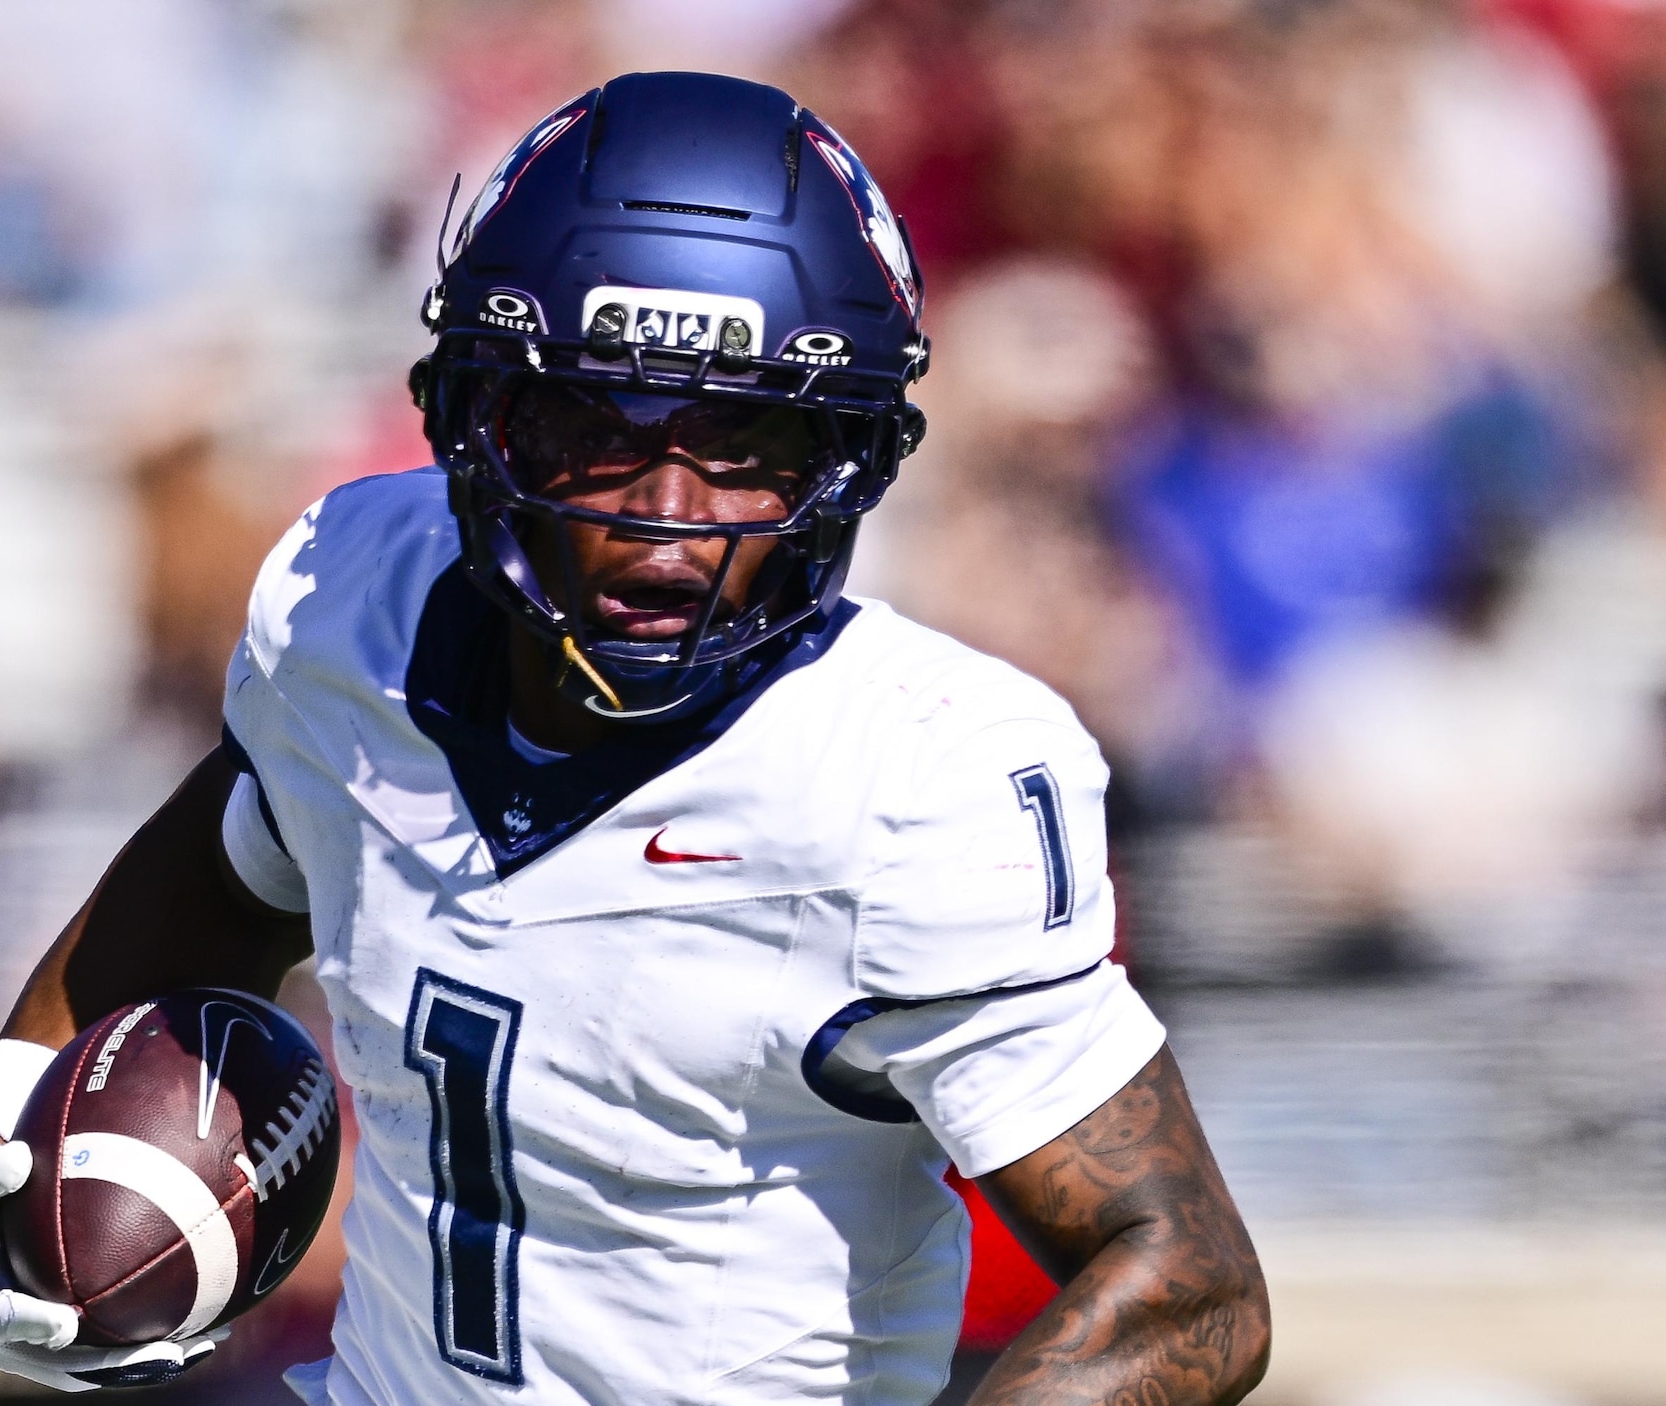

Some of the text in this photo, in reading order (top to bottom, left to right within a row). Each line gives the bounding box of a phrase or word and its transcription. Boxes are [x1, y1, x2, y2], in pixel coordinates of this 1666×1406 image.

[479, 312, 537, 332] OAKLEY
[782, 353, 851, 366] OAKLEY
[1007, 762, 1075, 932] 1
[86, 1033, 127, 1093] ELITE
[404, 966, 525, 1387] 1
